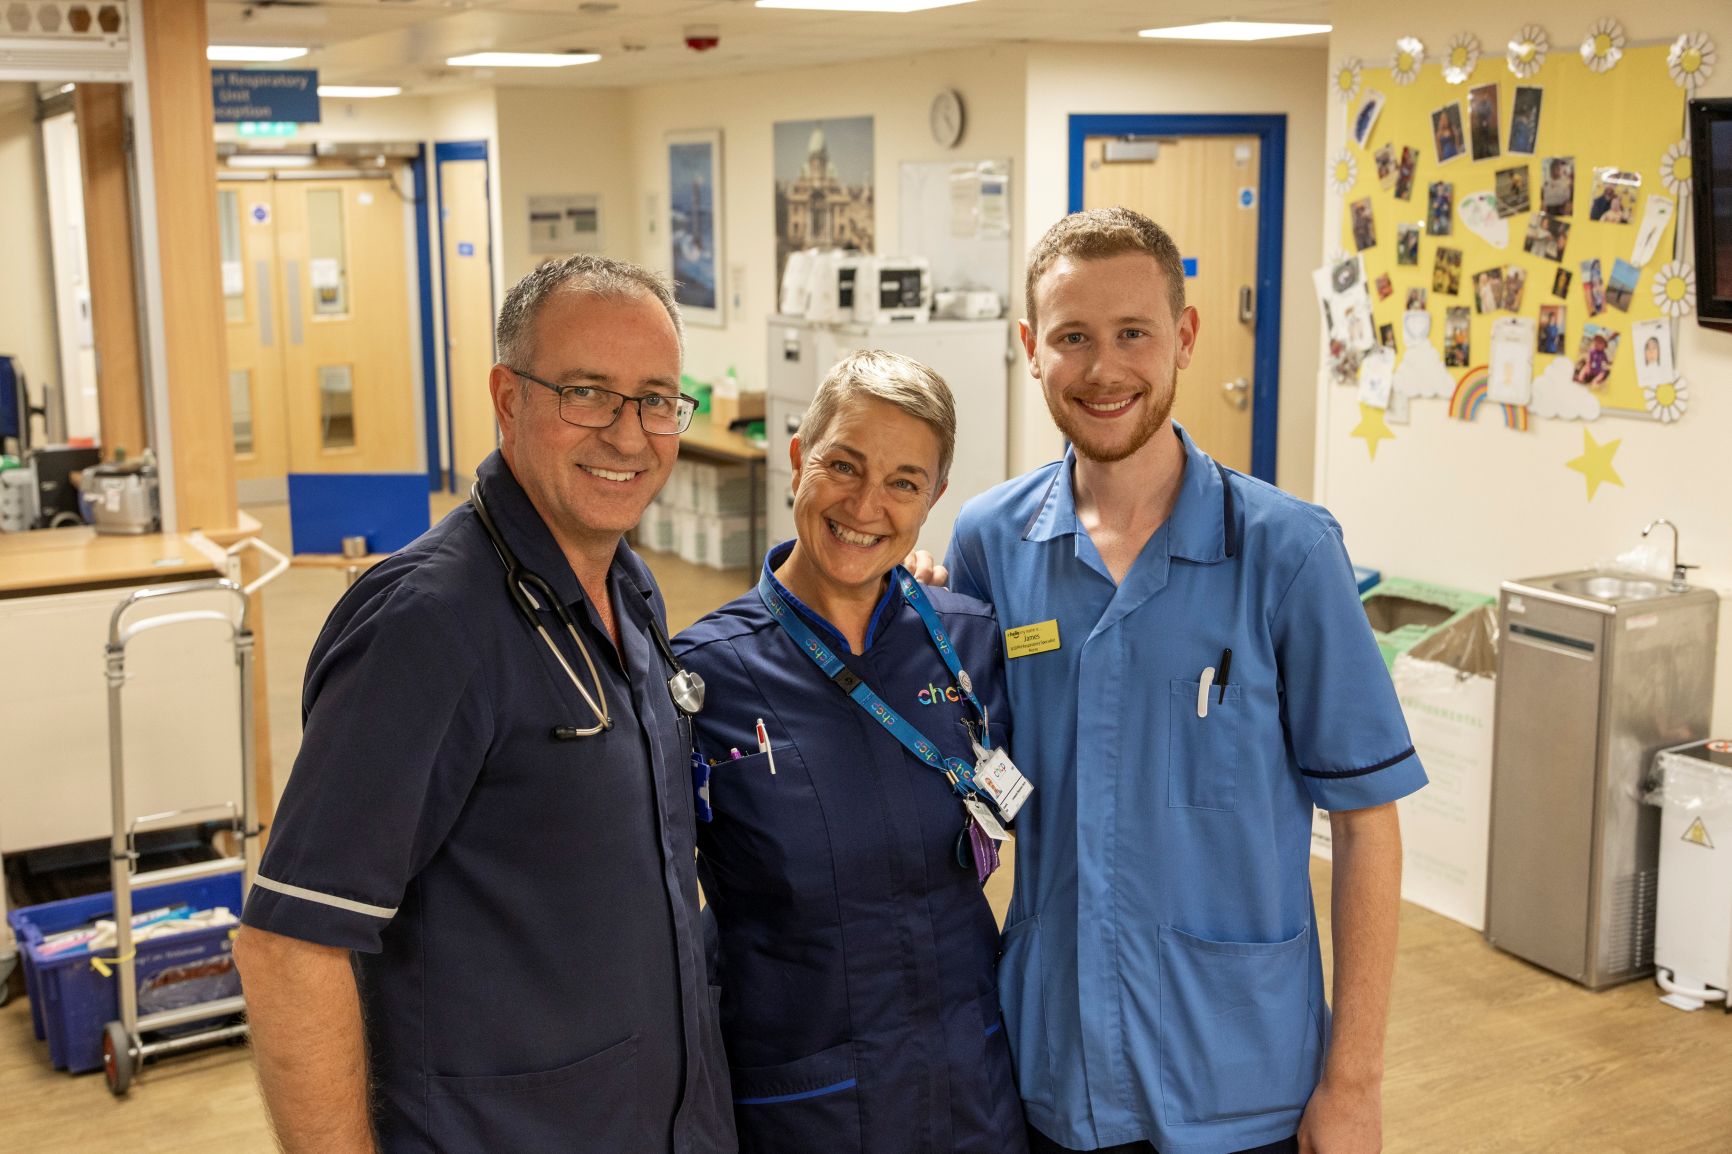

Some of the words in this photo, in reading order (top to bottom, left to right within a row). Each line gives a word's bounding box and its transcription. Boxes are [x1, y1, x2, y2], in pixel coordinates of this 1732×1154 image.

[228, 74, 308, 90] Respiratory
[219, 90, 250, 102] Unit
[1024, 634, 1040, 642] James
